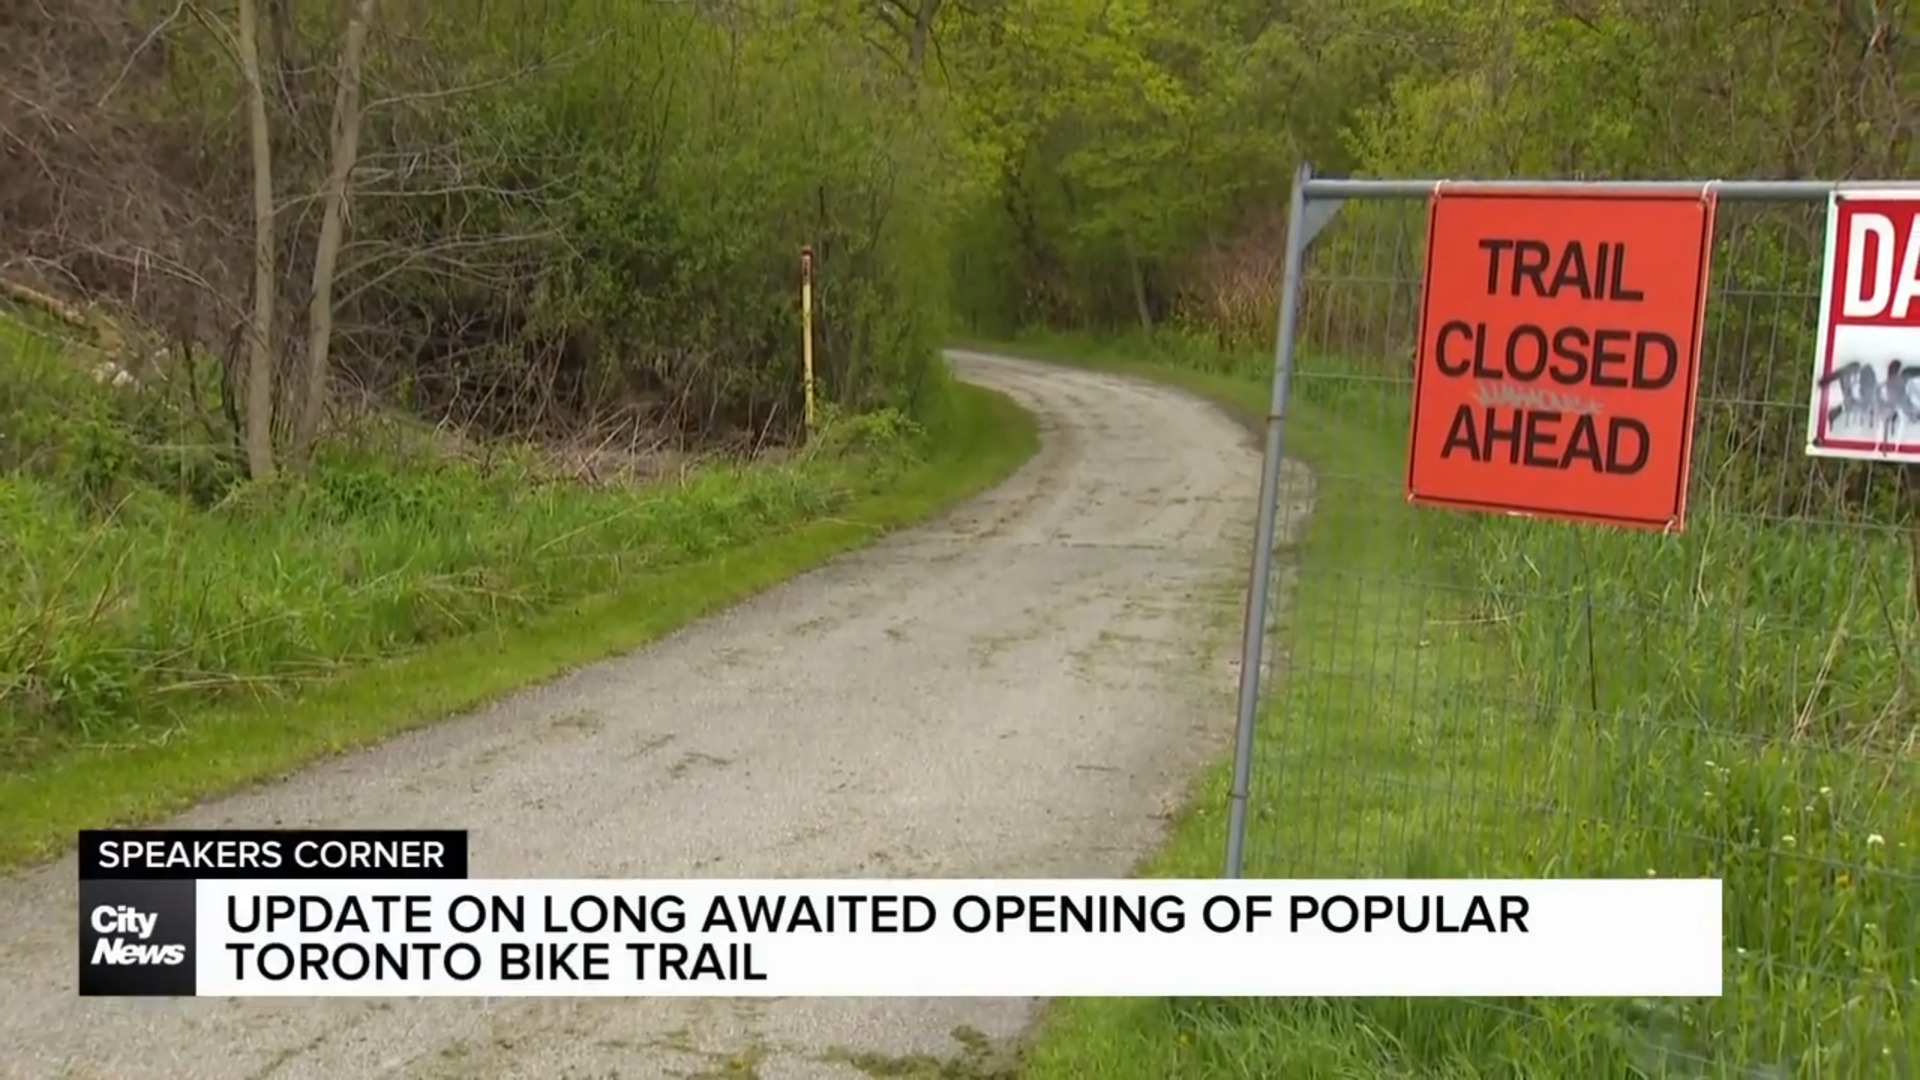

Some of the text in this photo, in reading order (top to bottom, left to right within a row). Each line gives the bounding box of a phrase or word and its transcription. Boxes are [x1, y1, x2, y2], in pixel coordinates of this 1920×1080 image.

[1478, 238, 1644, 302] TRAIL
[1435, 320, 1679, 391] CLOSED
[1440, 404, 1651, 476] AHEAD
